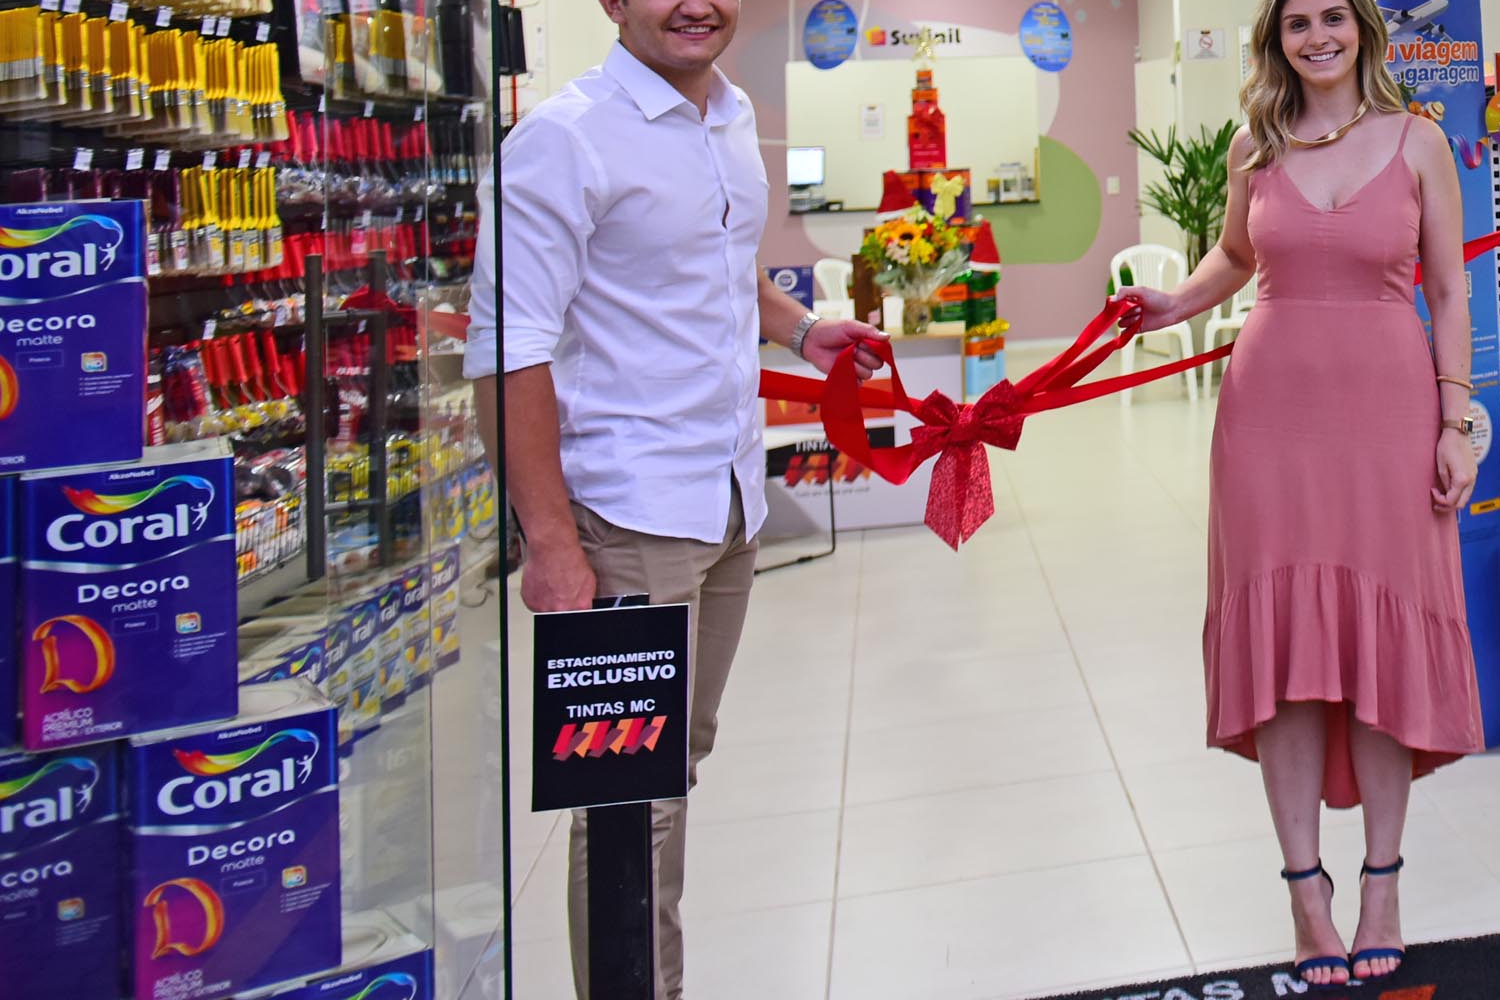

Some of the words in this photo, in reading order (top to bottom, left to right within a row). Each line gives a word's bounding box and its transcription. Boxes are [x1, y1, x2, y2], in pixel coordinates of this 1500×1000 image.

[1400, 36, 1478, 66] viagem
[1405, 65, 1479, 87] garagem
[16, 334, 64, 347] matte
[46, 504, 189, 552] Coral
[77, 575, 190, 604] Decora
[112, 598, 158, 614] matte
[548, 650, 675, 669] ESTACIONAMENTO
[548, 664, 676, 689] EXCLUSIVO
[566, 701, 624, 719] TINTAS
[630, 699, 655, 713] MC
[157, 758, 295, 815] Coral
[188, 829, 295, 866] Decora
[220, 855, 265, 873] matte
